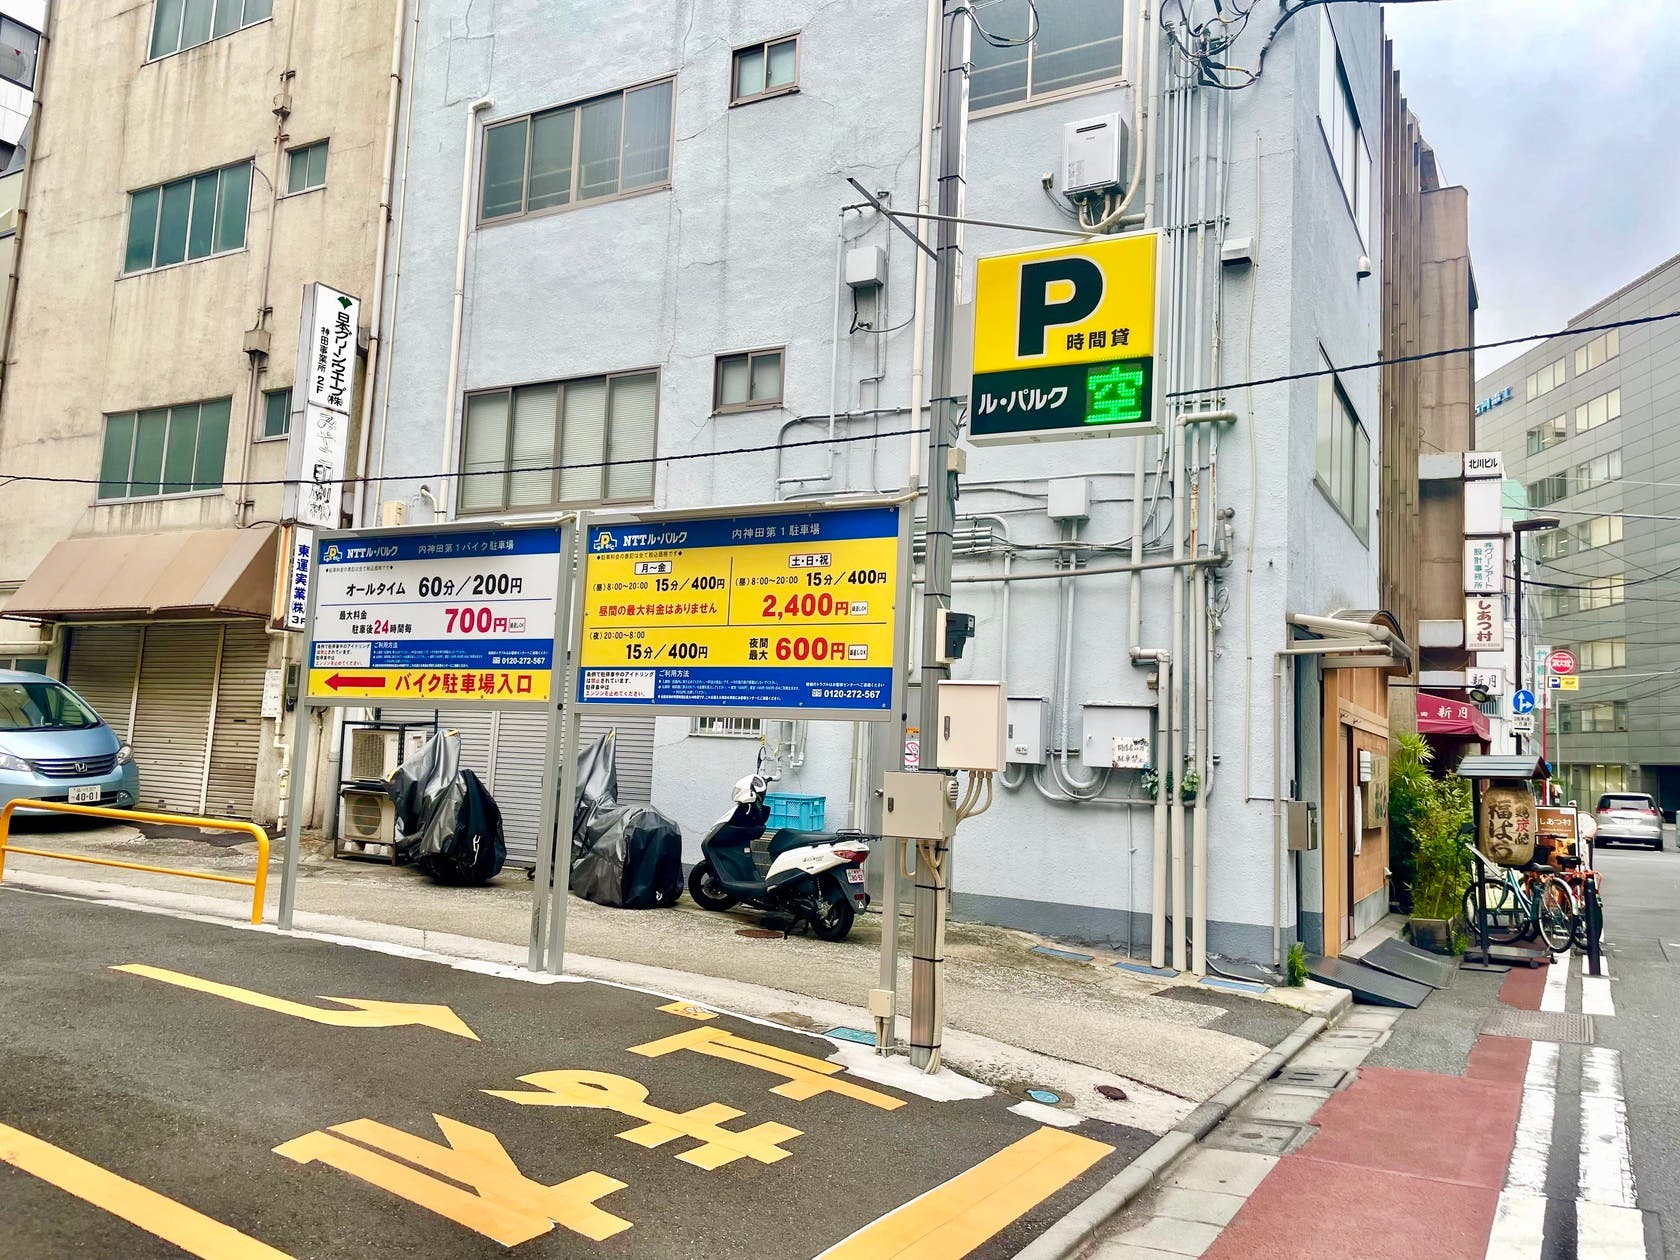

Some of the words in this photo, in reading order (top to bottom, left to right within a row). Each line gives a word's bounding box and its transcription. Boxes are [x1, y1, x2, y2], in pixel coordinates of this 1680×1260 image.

[1017, 257, 1104, 358] P
[1066, 328, 1130, 350] 時間貸
[317, 327, 330, 373] 神田事業所
[316, 375, 325, 394] 2F
[979, 386, 1068, 415] ル・パルク
[1084, 366, 1143, 423] 空
[1468, 458, 1498, 469] 北川ビル
[791, 555, 829, 567] 土・日・祝
[346, 581, 406, 597] オールタイム
[599, 603, 717, 617] 昼間の最大料金はありません
[762, 592, 849, 620] 2,400円
[339, 610, 367, 621] 最大料金
[445, 607, 507, 633] 700円
[1476, 600, 1493, 642] しあつ村
[352, 619, 412, 635] 駐車後24時間毎
[749, 638, 768, 649] 夜間
[775, 637, 845, 660] 600円
[502, 657, 545, 665] 0120-272-567
[749, 650, 768, 660] 最大
[659, 670, 690, 678] ご利用方法
[1471, 674, 1496, 688] 新月
[396, 673, 532, 694] バイク駐車場入口
[824, 689, 881, 699] 0120-272-567
[1437, 705, 1468, 719] 新月
[1540, 818, 1571, 826] しあつ村
